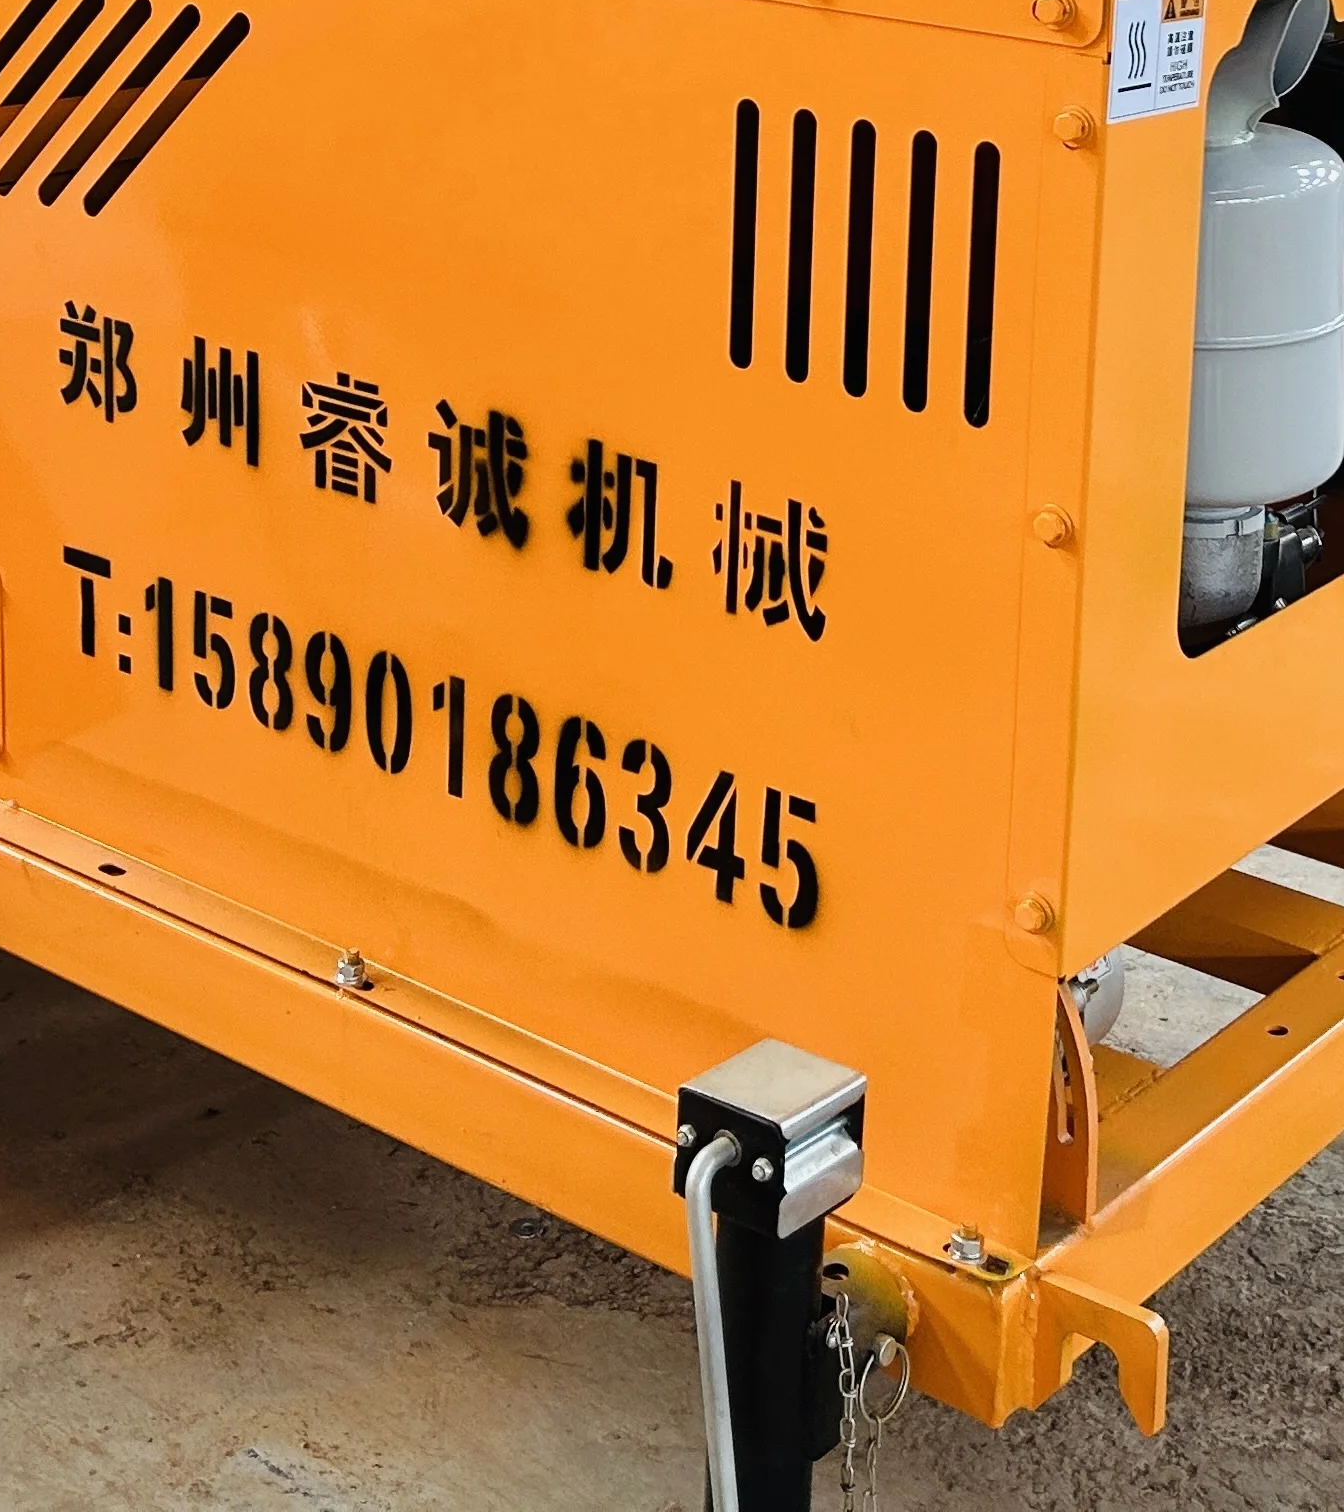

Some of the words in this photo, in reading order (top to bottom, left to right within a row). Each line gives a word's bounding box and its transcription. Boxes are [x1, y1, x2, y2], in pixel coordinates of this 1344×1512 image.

[60, 301, 828, 642] 郑州睿诚机械
[64, 546, 820, 930] T:15890186345
